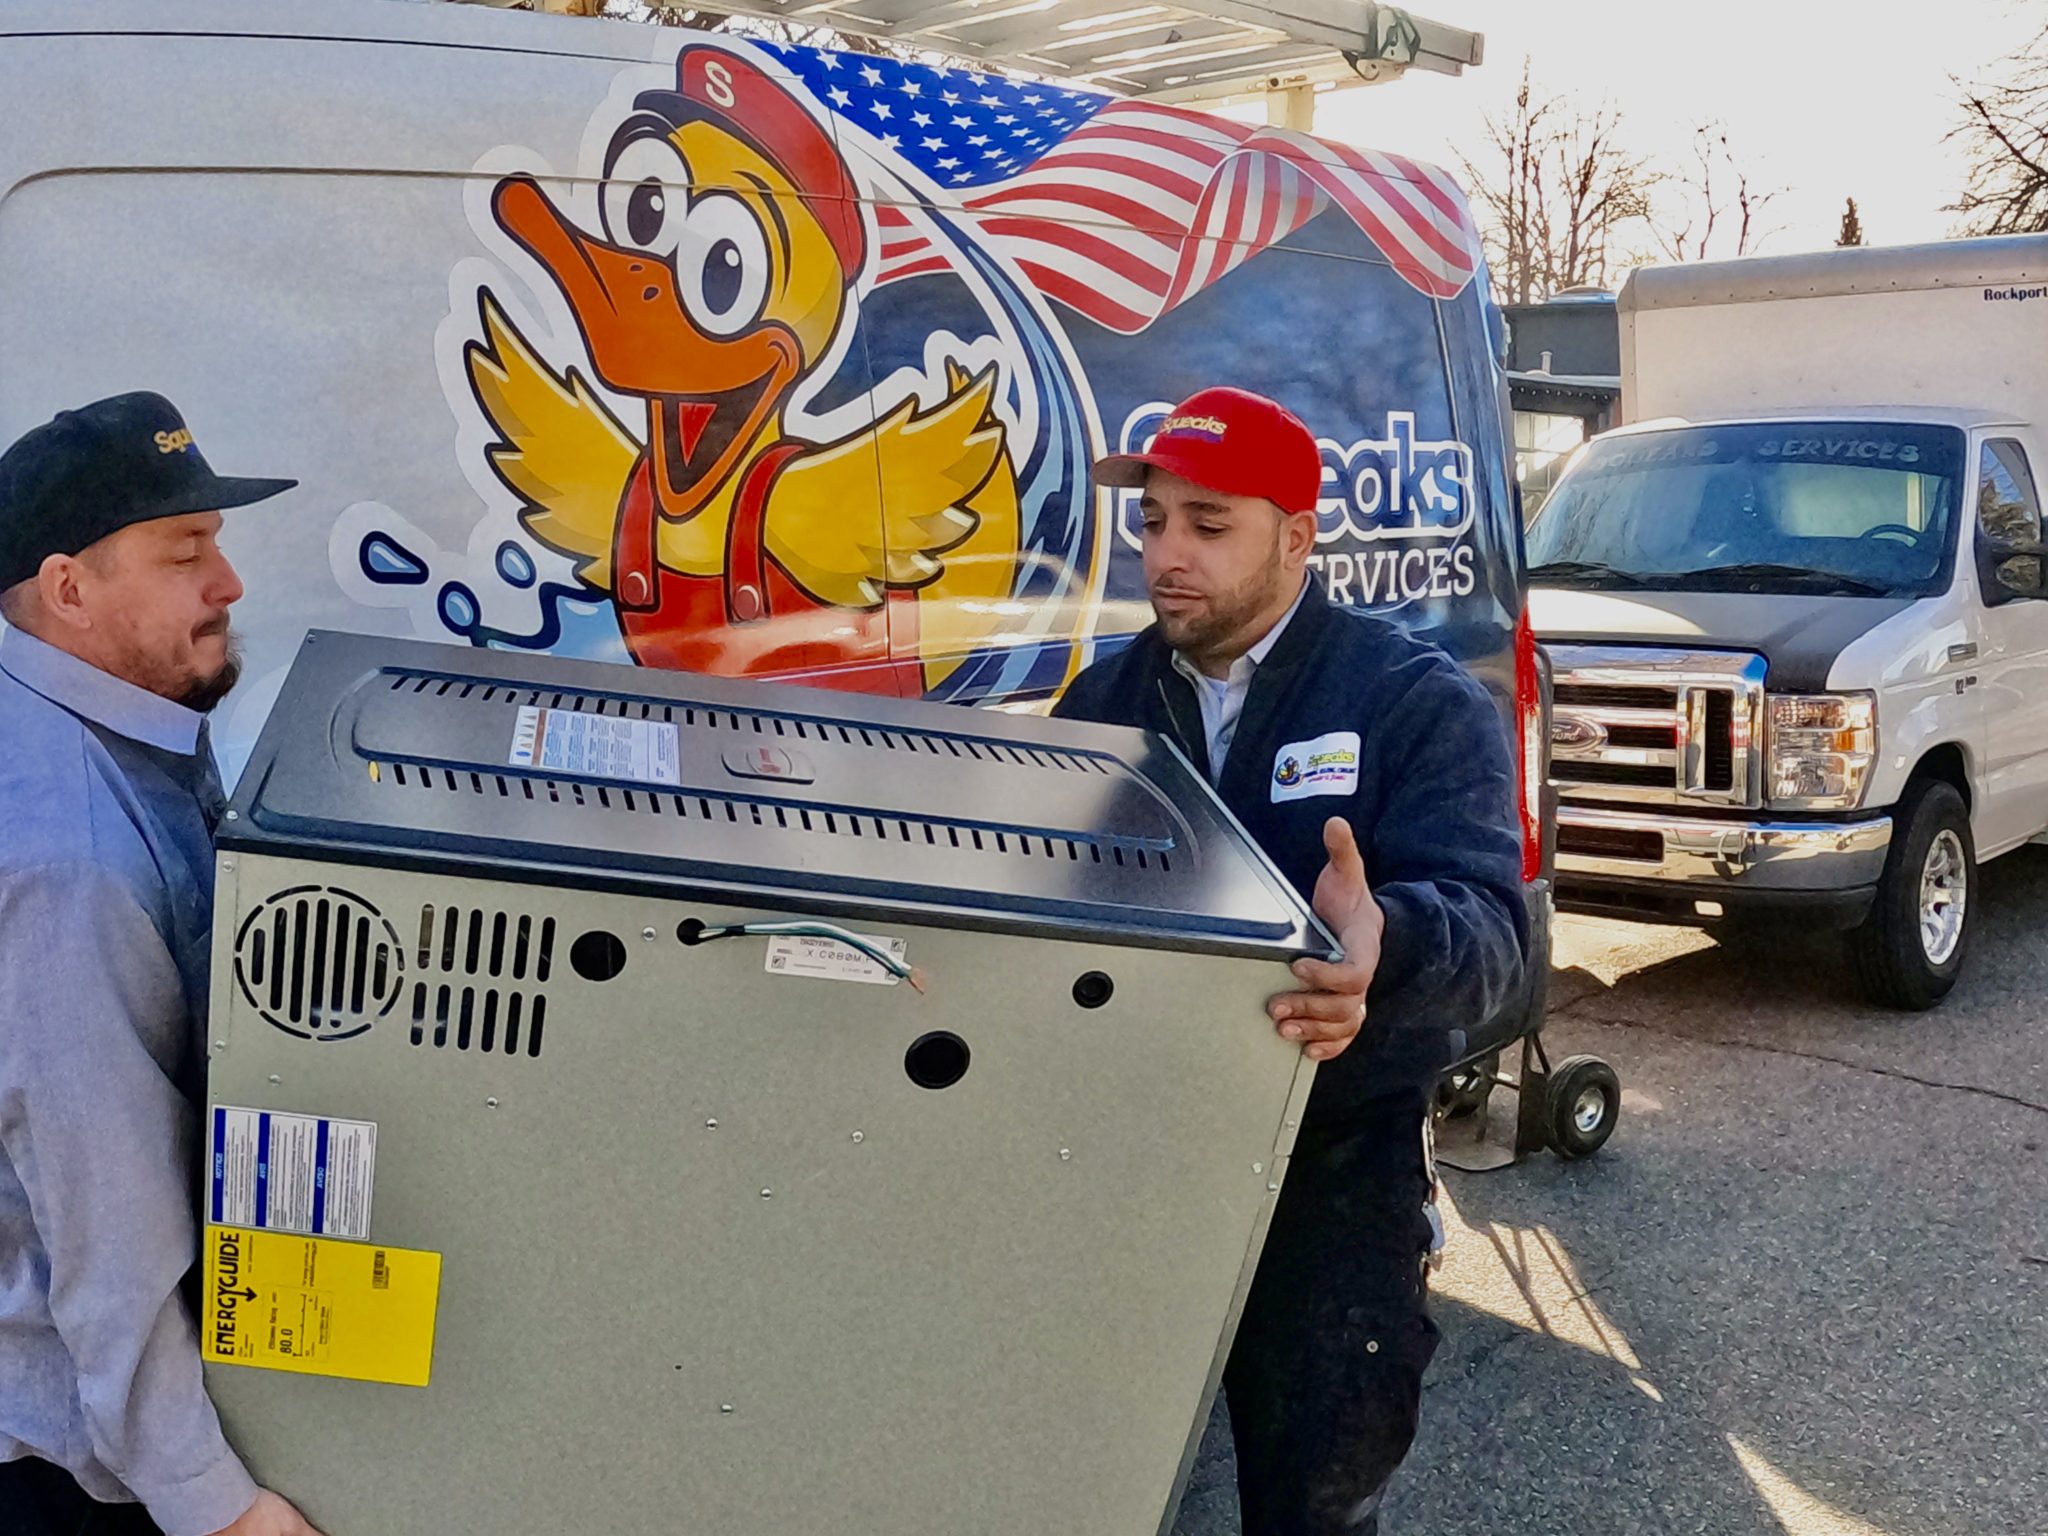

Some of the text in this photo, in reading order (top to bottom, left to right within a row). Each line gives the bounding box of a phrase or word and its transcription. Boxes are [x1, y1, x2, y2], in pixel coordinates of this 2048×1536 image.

[704, 60, 736, 108] S
[1757, 440, 1920, 462] SERVICES
[1305, 545, 1475, 604] RVICES
[216, 1231, 243, 1356] ENERGYGUIDE
[280, 1328, 293, 1354] 80.0
